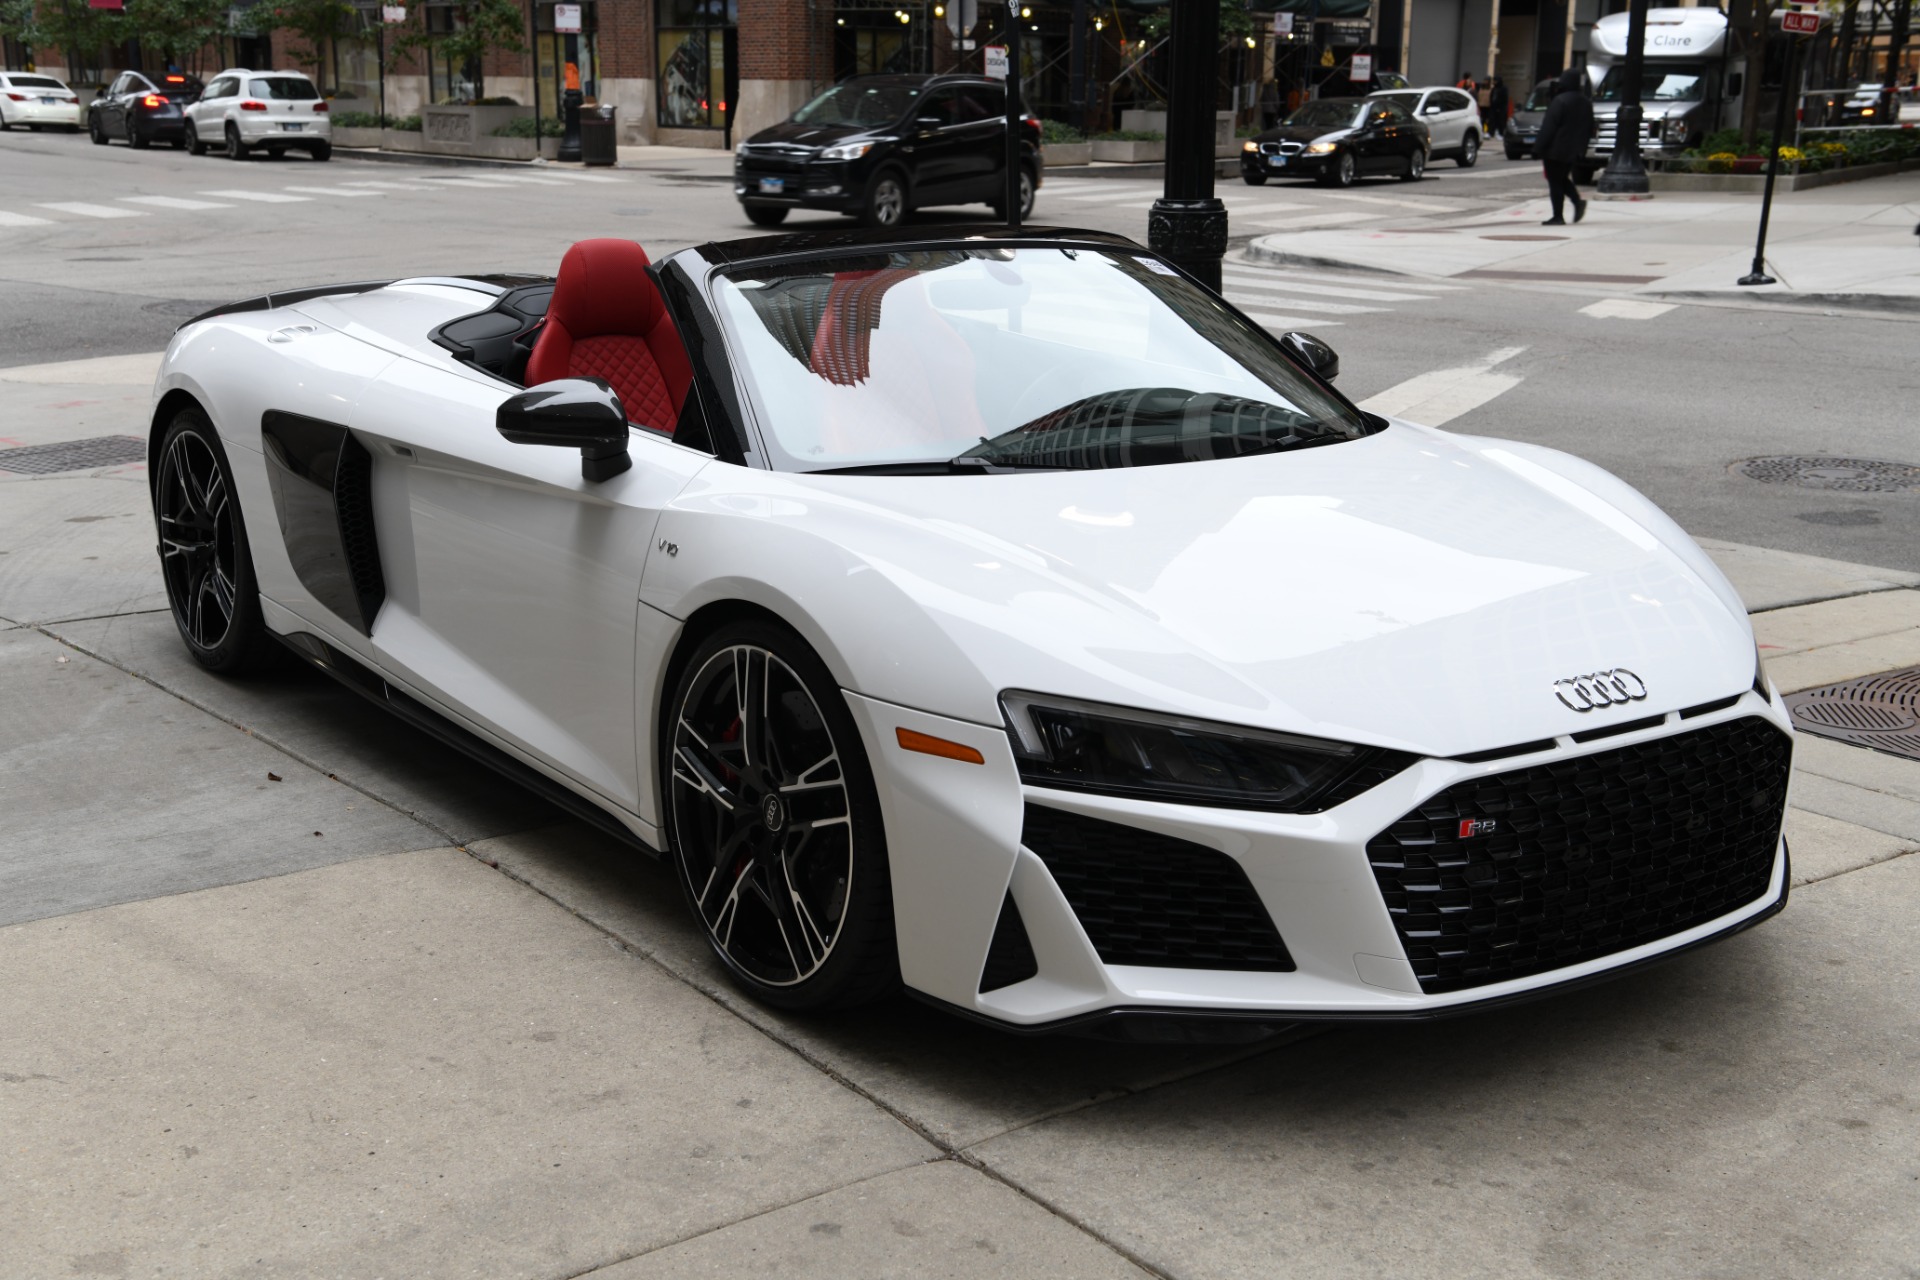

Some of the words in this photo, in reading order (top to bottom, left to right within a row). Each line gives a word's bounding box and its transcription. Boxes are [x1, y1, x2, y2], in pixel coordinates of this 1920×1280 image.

[1785, 15, 1800, 28] ALL
[1801, 16, 1816, 30] WAY
[1653, 34, 1692, 47] Clare
[986, 57, 1006, 68] DESIGN
[658, 537, 680, 557] V10
[1467, 819, 1497, 836] R8
